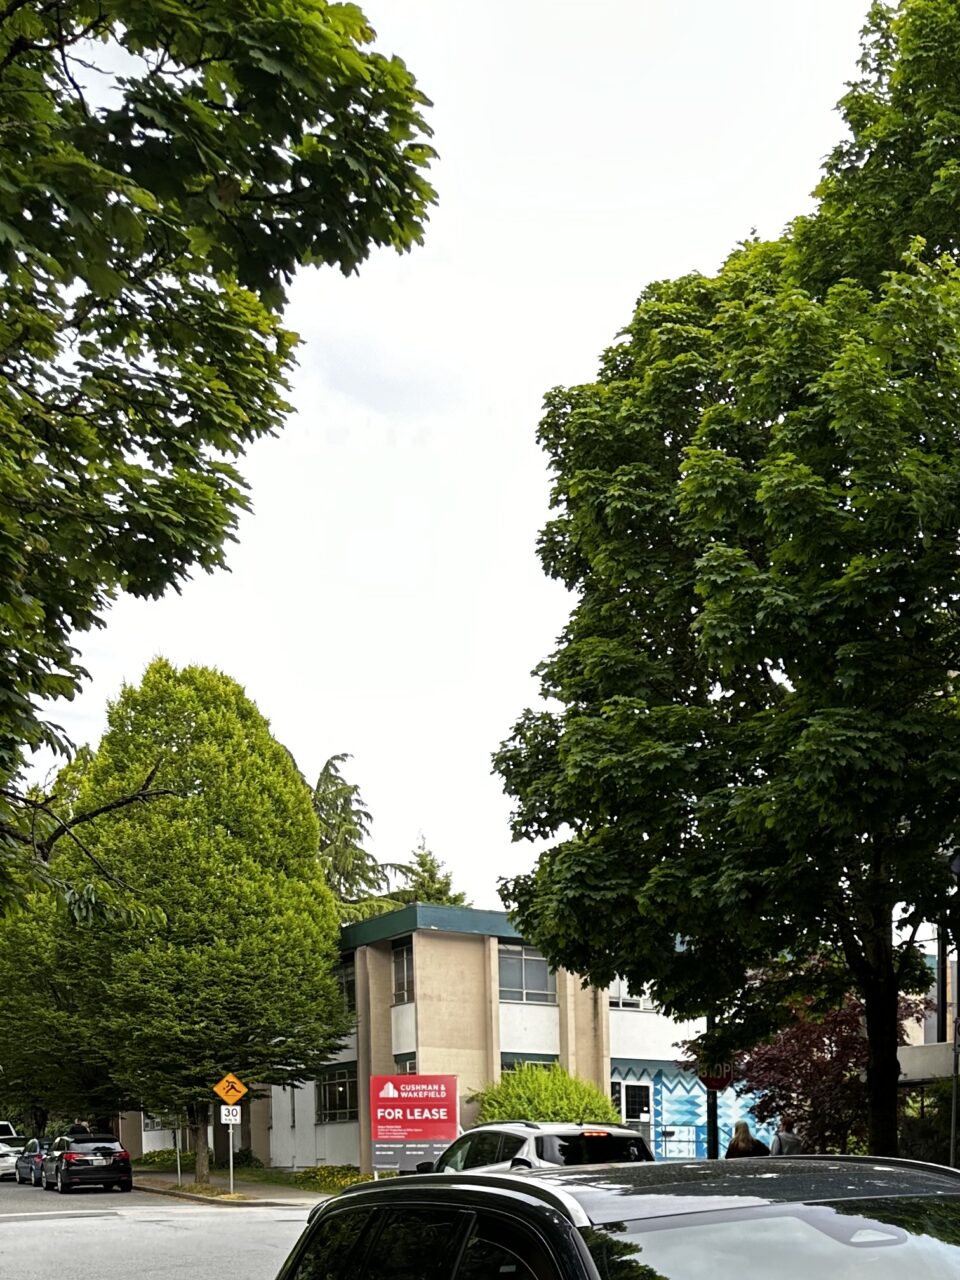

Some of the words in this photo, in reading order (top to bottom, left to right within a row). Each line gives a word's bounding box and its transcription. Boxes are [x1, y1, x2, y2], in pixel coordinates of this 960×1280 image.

[224, 1107, 238, 1117] 30
[377, 1108, 403, 1120] FOR
[406, 1108, 448, 1120] LEASE
